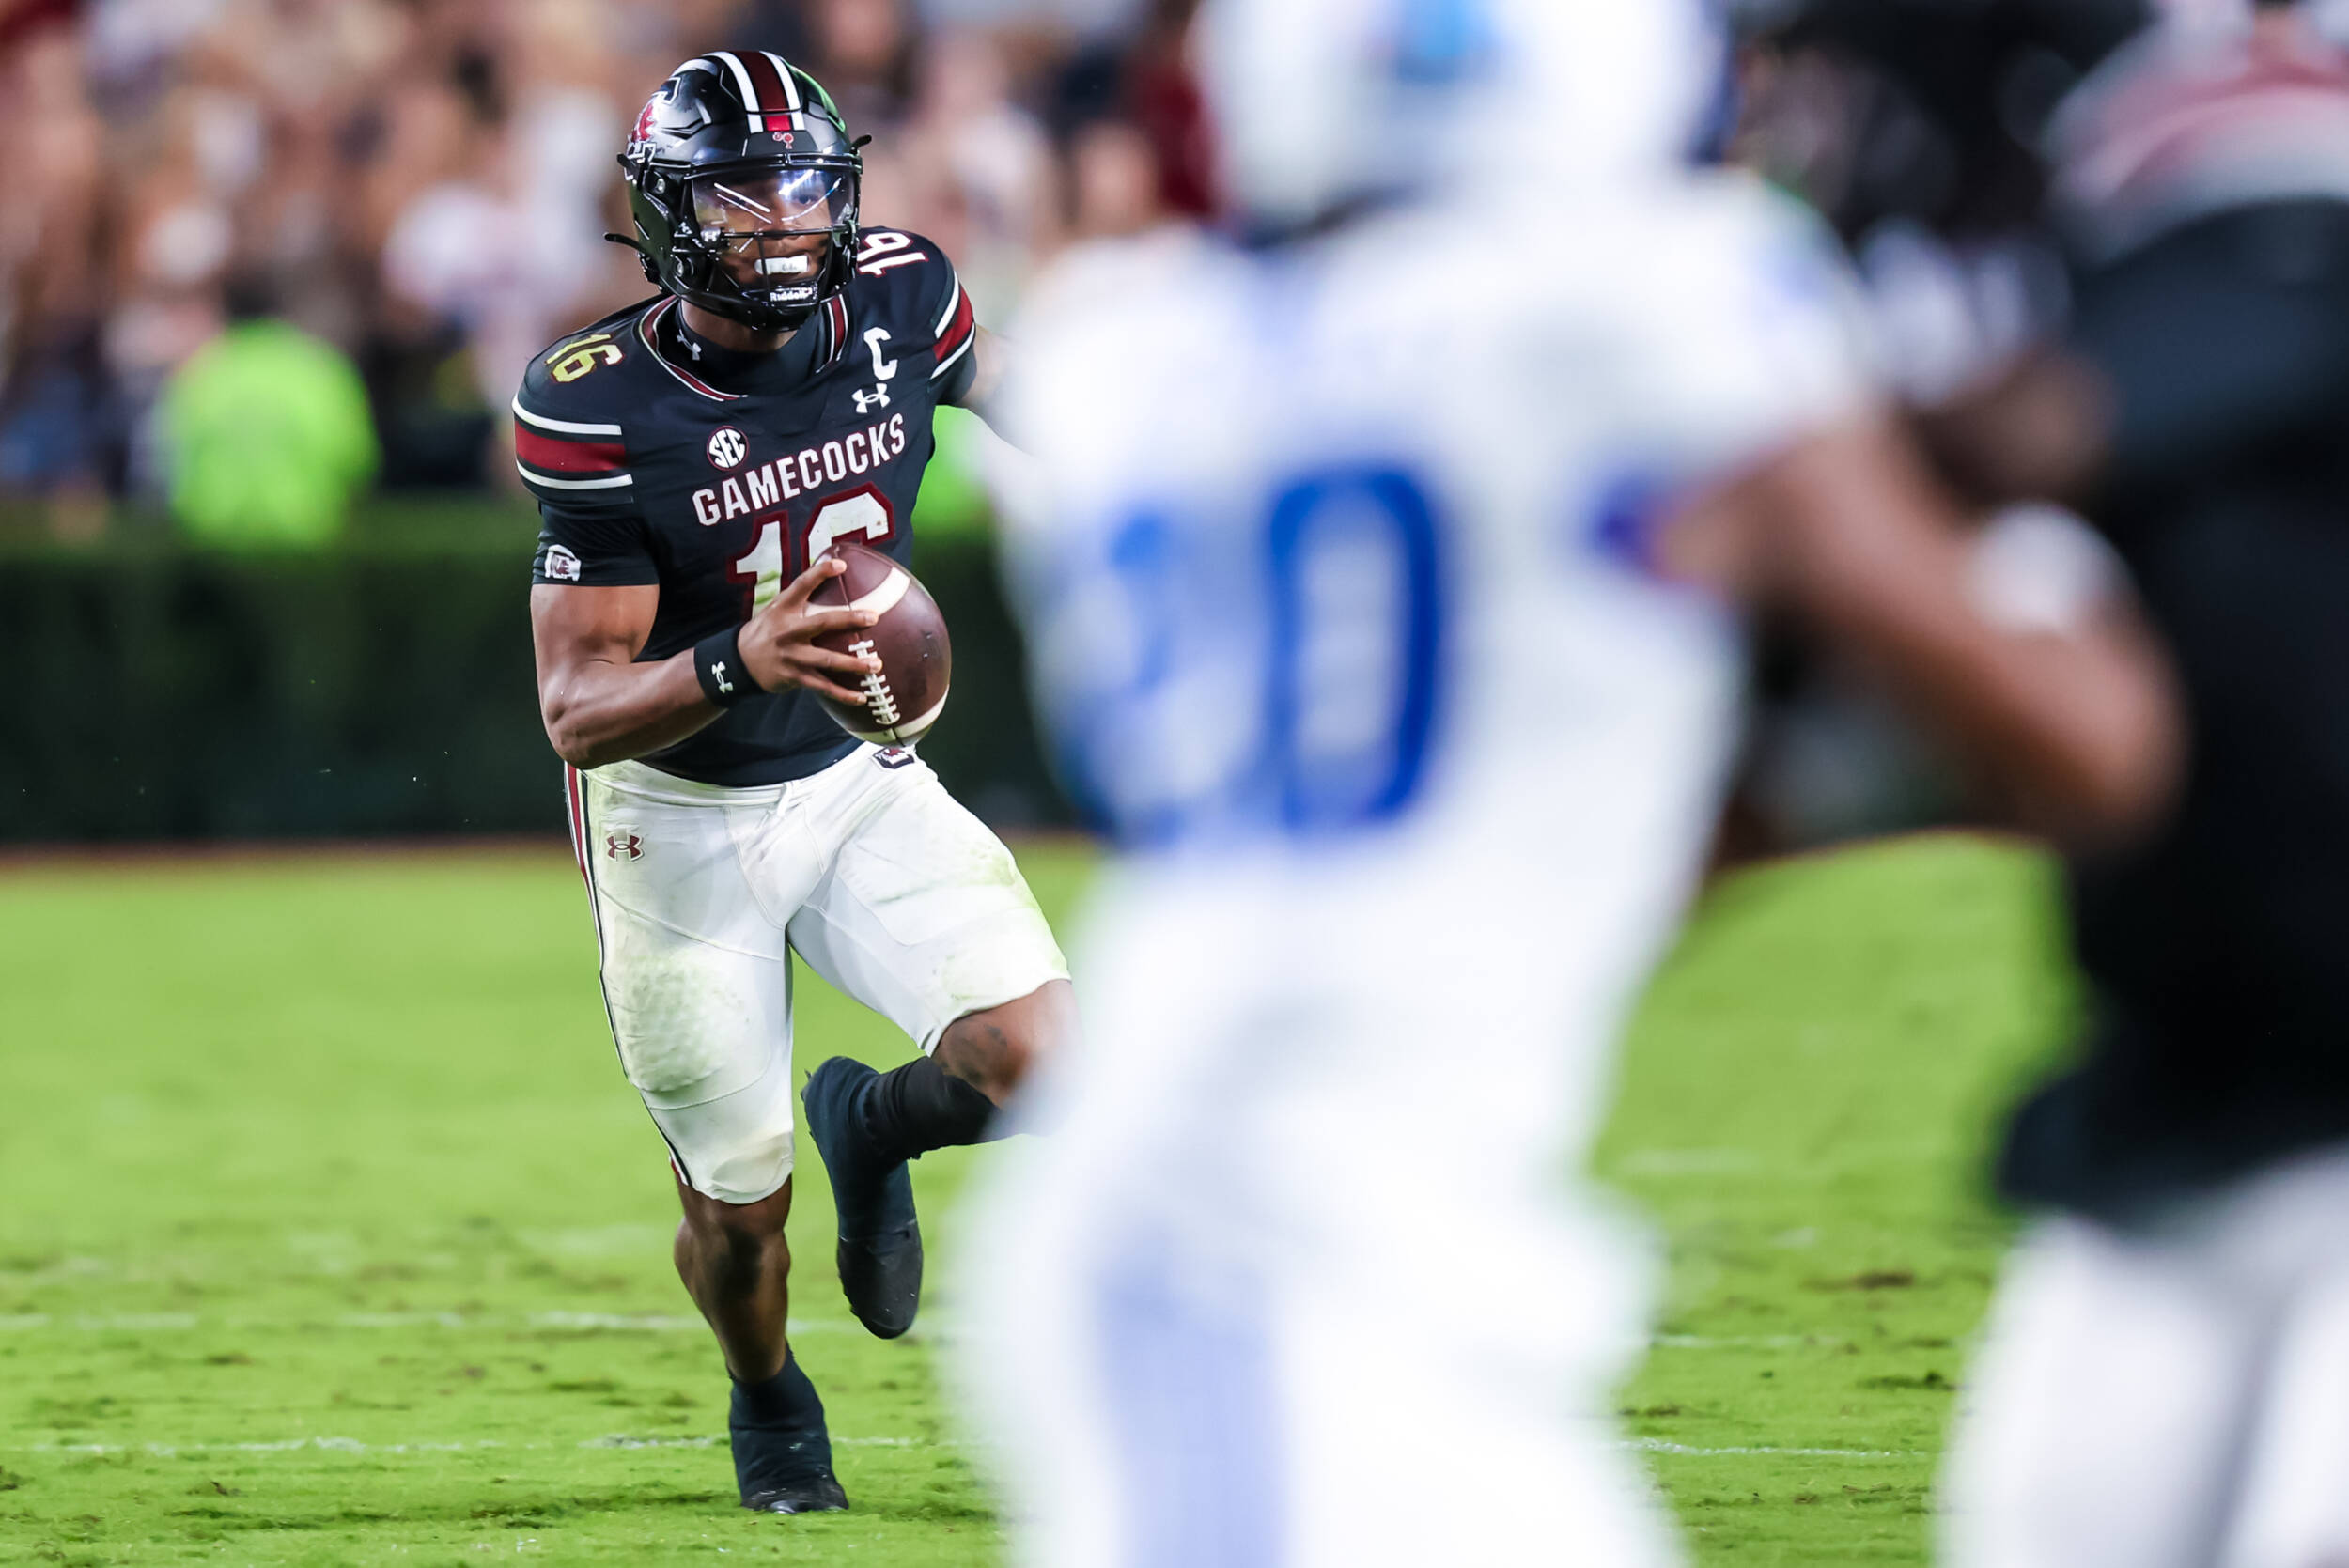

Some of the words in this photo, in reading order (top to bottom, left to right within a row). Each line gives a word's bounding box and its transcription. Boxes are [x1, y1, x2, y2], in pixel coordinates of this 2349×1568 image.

[545, 334, 626, 382] 16
[863, 327, 898, 380] C
[692, 412, 906, 526] GAMECOCKS
[708, 427, 748, 469] SEC
